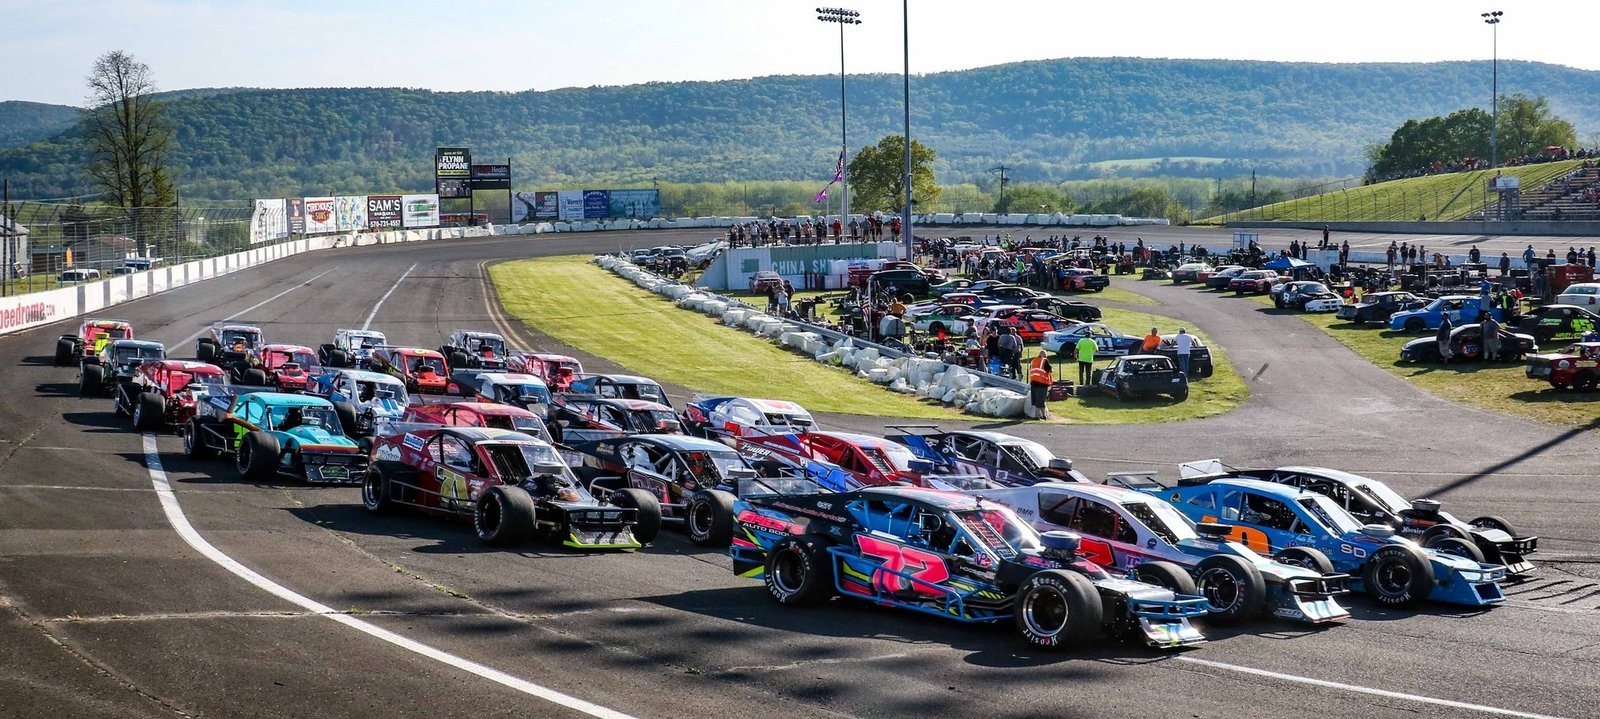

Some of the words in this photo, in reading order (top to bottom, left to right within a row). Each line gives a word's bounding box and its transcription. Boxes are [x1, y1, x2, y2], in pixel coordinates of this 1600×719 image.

[438, 162, 469, 170] PROPANE
[369, 200, 400, 212] SAM'S
[771, 260, 805, 275] CHINA
[742, 522, 767, 532] AUTO
[857, 534, 950, 597] 72
[1021, 627, 1060, 646] Hoosier
